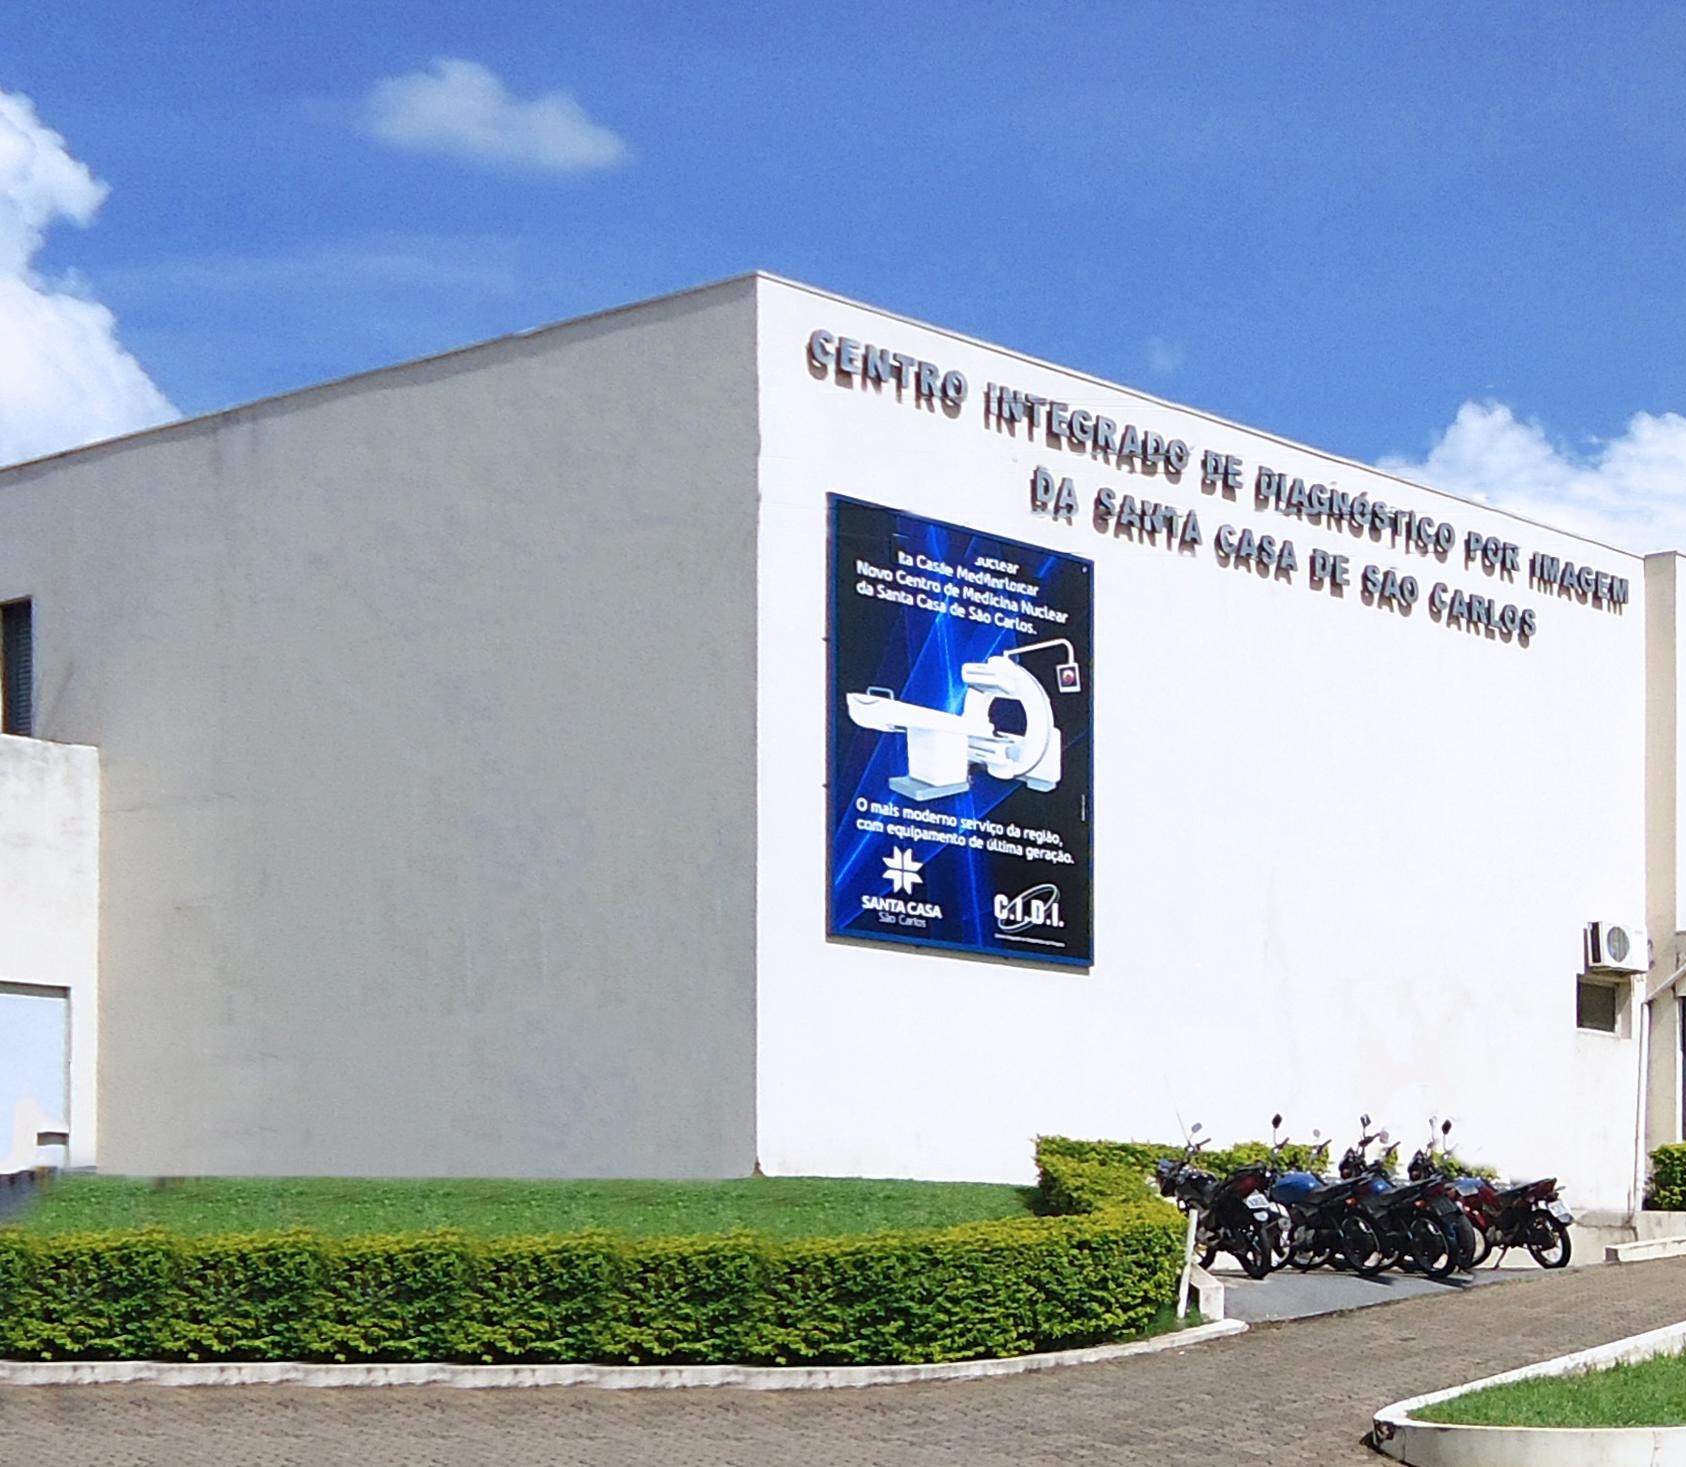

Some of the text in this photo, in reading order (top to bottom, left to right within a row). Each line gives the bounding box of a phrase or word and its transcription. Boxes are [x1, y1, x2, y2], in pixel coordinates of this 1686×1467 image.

[806, 328, 1629, 605] CENTRO INTEGRADO DE DIAGNÓSTICO POR IMAGEM
[1031, 464, 1537, 638] DA SANTA CASA DE SÃO CARLOS
[856, 560, 1069, 624] Novo Centro de Medicina Nuclear
[856, 580, 1038, 635] da Santa Casa de São Carlos.
[856, 797, 1064, 848] O mais moderno serviço da região,
[856, 819, 1075, 865] com equipamento de última geração.
[861, 895, 943, 919] SANTA CASA
[994, 894, 1065, 928] C.I.D.I.
